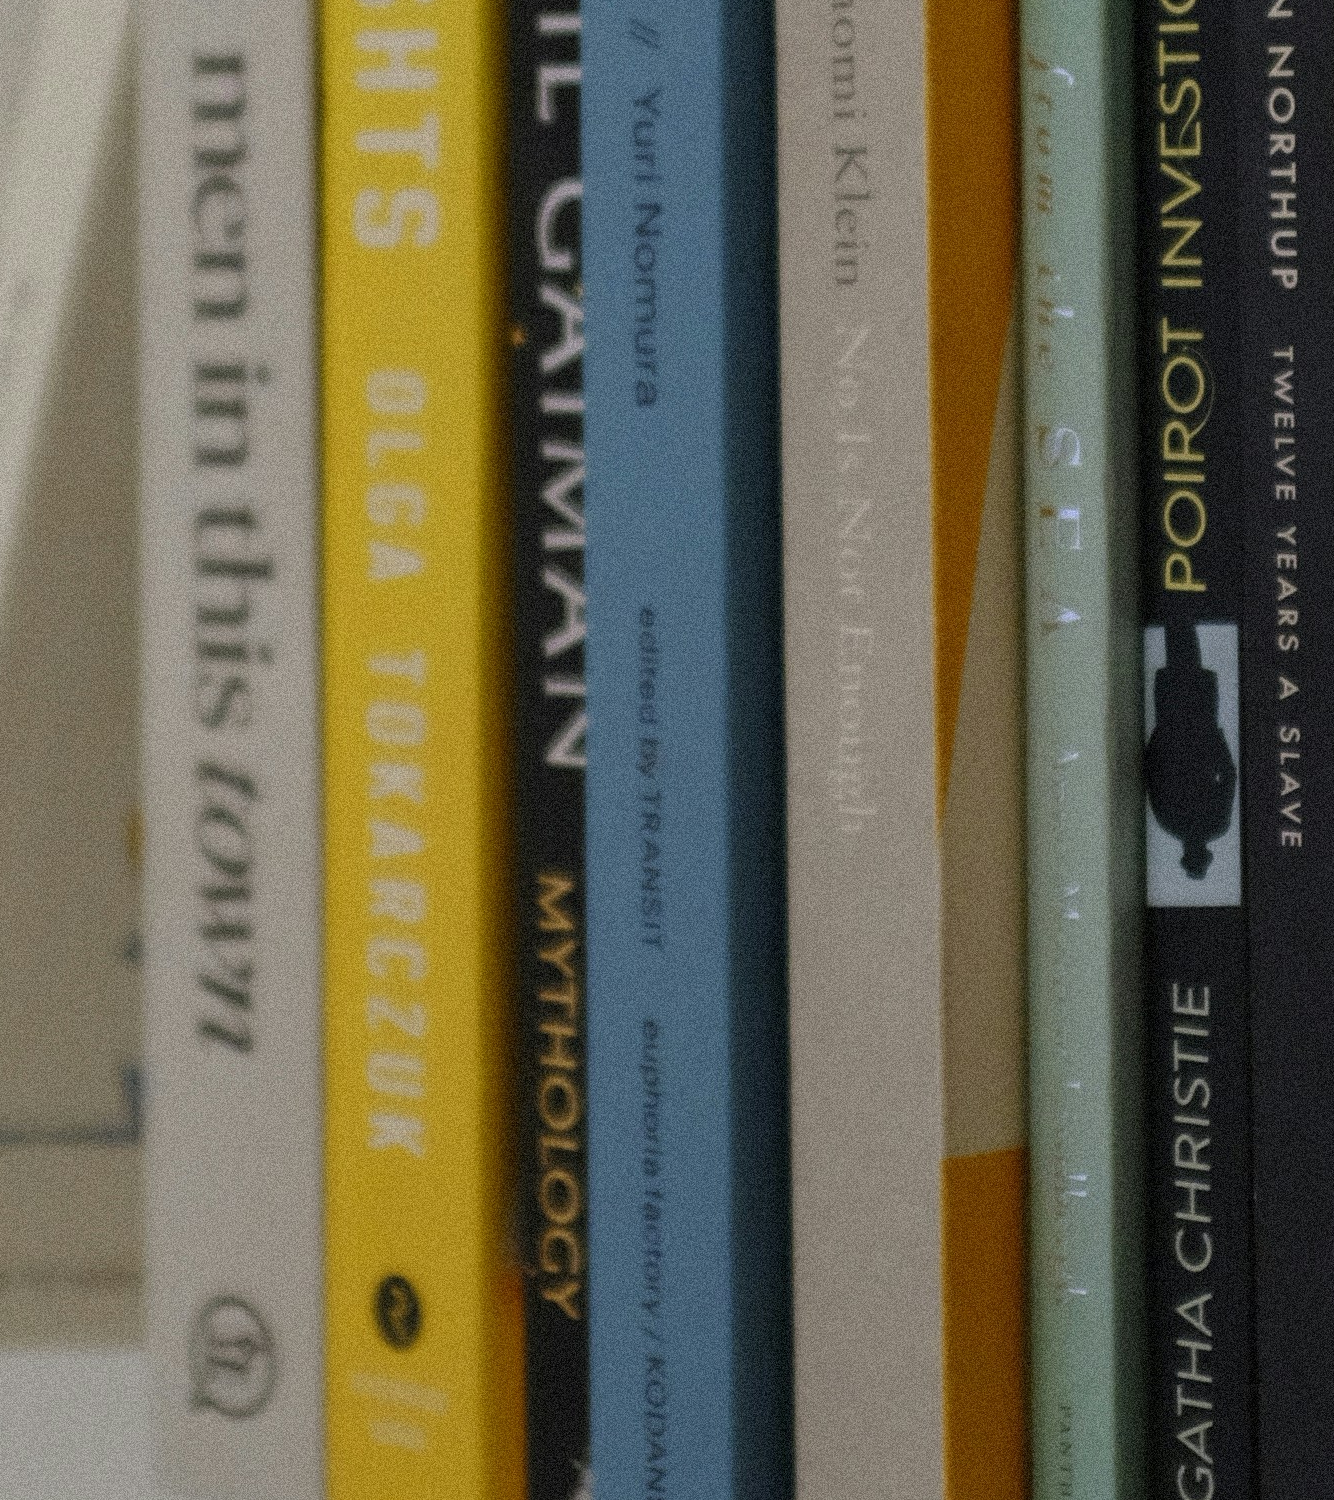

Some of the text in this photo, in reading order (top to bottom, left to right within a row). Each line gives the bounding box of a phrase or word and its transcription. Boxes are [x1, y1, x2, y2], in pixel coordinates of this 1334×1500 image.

[630, 88, 664, 184] Yuri
[833, 144, 873, 288] Klein
[1026, 49, 1077, 215] from
[1267, 45, 1299, 291] NORTHUP
[631, 202, 665, 407] Nomura
[191, 50, 278, 1057] men in this town
[827, 325, 878, 834] No Is Not Enough
[1037, 426, 1083, 640] SEA
[1161, 317, 1216, 592] POIROT
[1271, 345, 1303, 850] TWELVE YEARS A SLAVE
[365, 370, 429, 1160] OLGA TOKARCZUK
[635, 606, 665, 952] edited by TRANSIT
[536, 871, 582, 1322] MYTHOLOGY
[638, 1019, 665, 1178] euphoria
[1172, 982, 1216, 1273] CHRISTIE
[639, 1189, 665, 1318] factory
